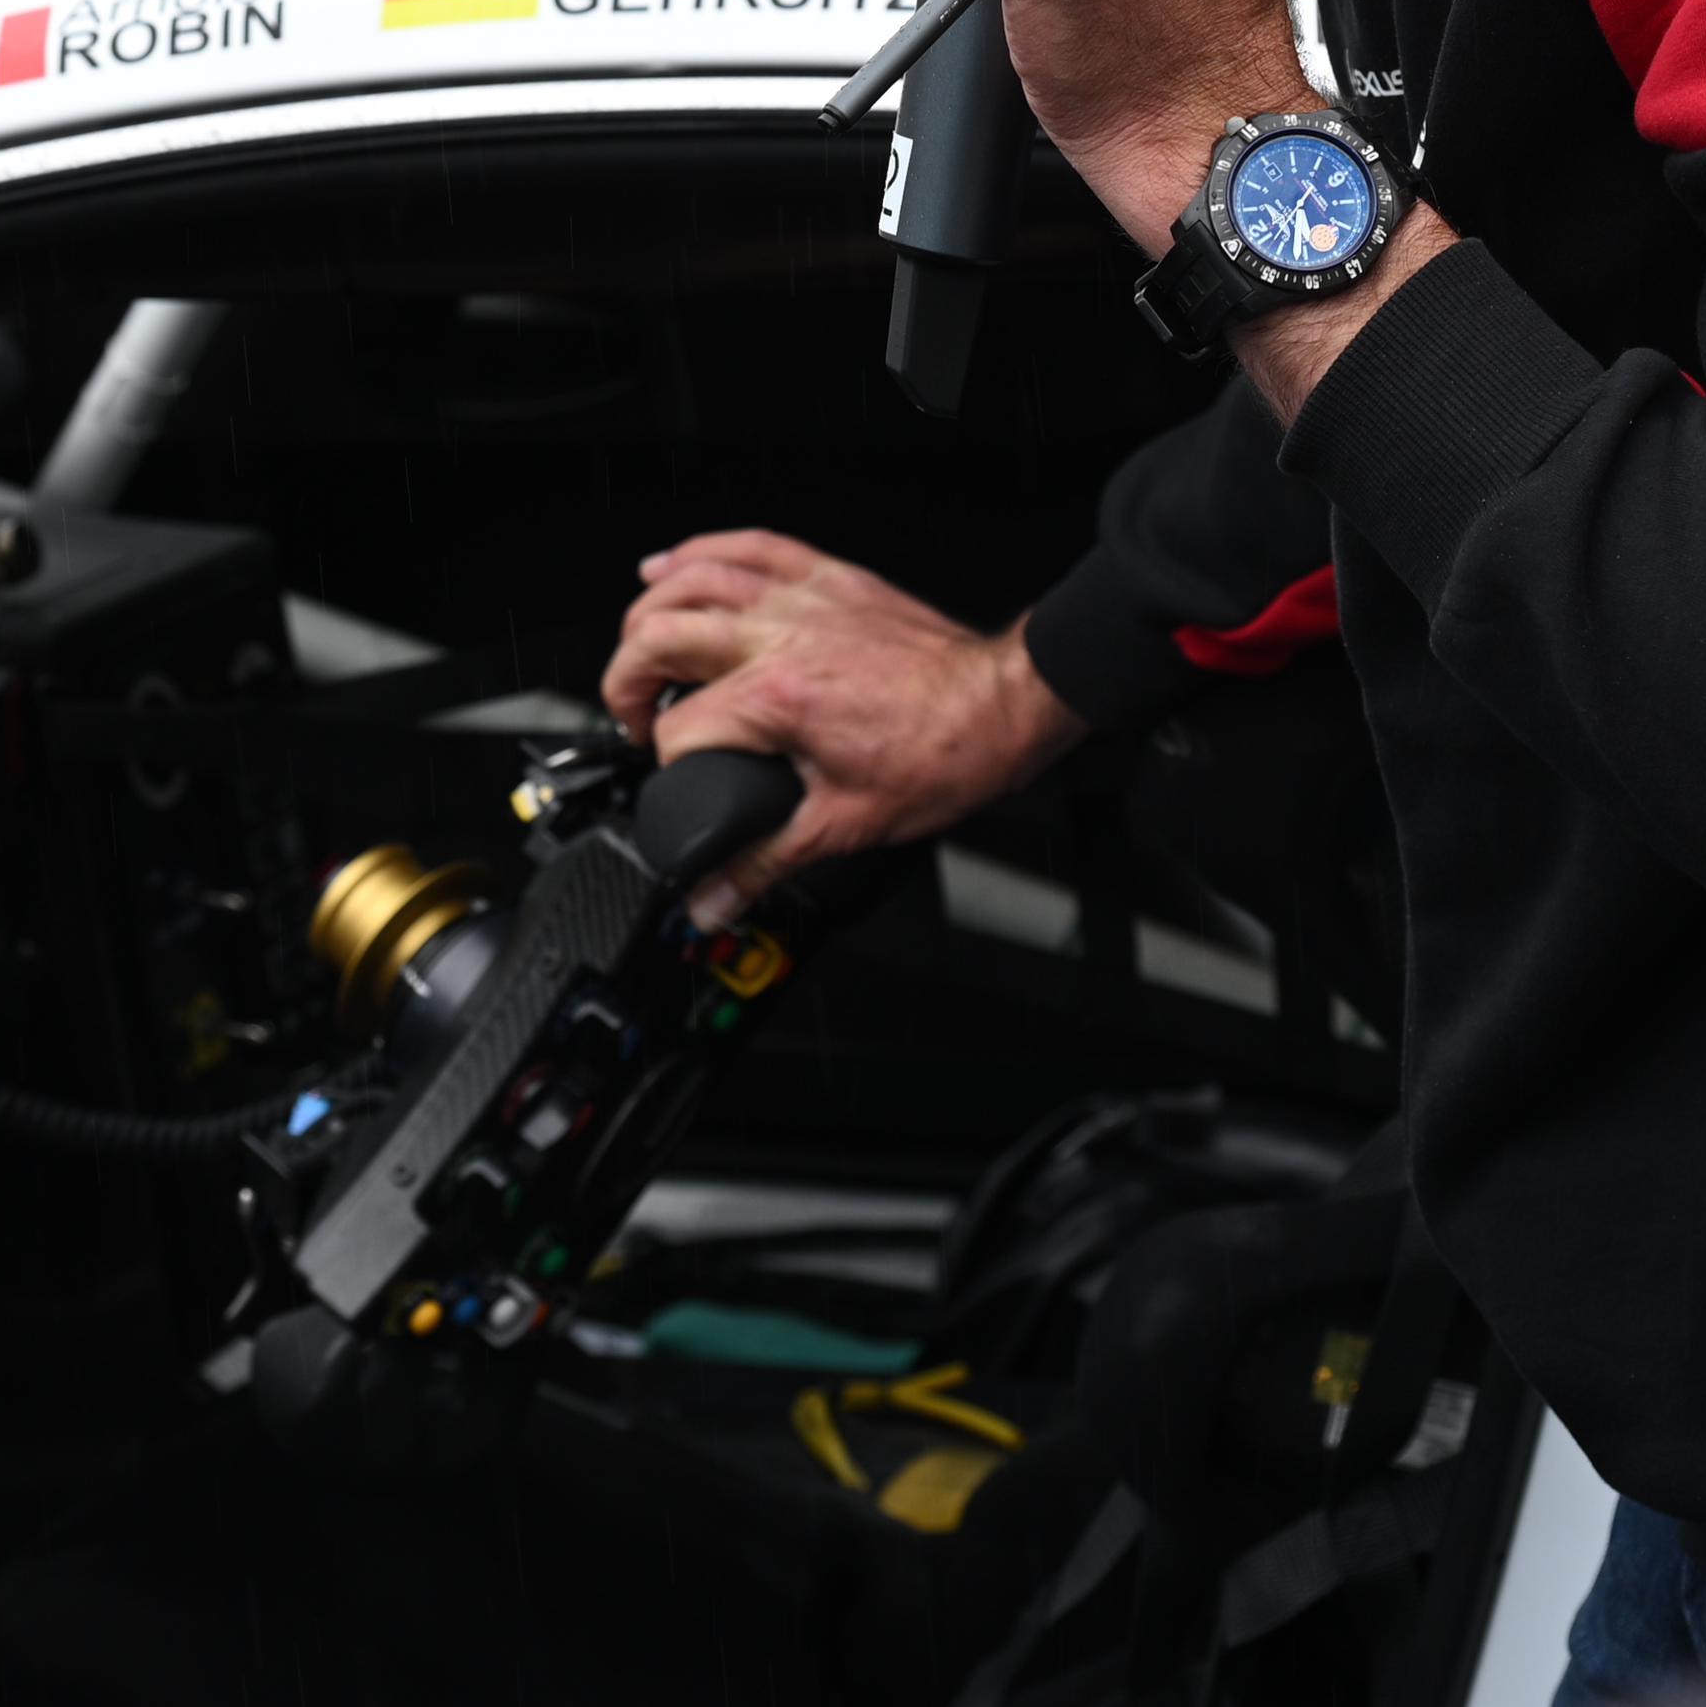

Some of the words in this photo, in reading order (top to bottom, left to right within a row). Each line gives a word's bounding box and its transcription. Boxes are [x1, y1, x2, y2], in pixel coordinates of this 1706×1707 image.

[58, 0, 284, 75] ROBIN
[1283, 114, 1298, 127] 20
[1325, 121, 1342, 136] 25
[1241, 124, 1260, 141] 15
[1360, 145, 1380, 164] 30
[1216, 159, 1232, 173] 10
[1344, 258, 1364, 280] 45
